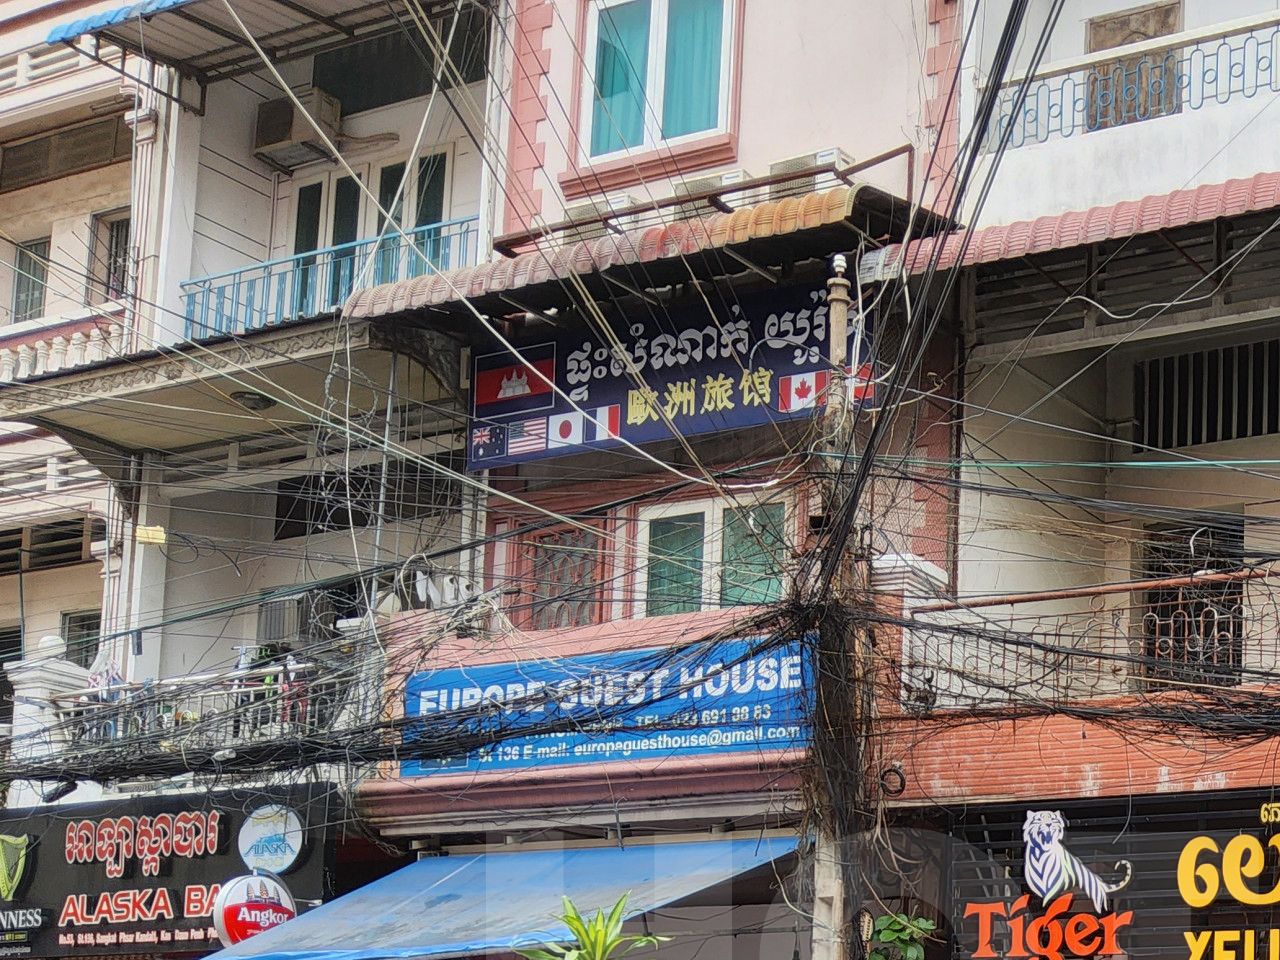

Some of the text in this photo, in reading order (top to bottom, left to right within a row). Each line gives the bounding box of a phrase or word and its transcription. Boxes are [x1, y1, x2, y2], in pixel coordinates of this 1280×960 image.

[419, 656, 801, 717] EUROPE GUEST HOUSE
[497, 746, 520, 762] 136
[573, 724, 800, 758] europeguesthouse@gmail.com
[244, 841, 296, 857] ALASKA
[58, 886, 174, 927] ALASKA
[237, 905, 290, 925] Angkor
